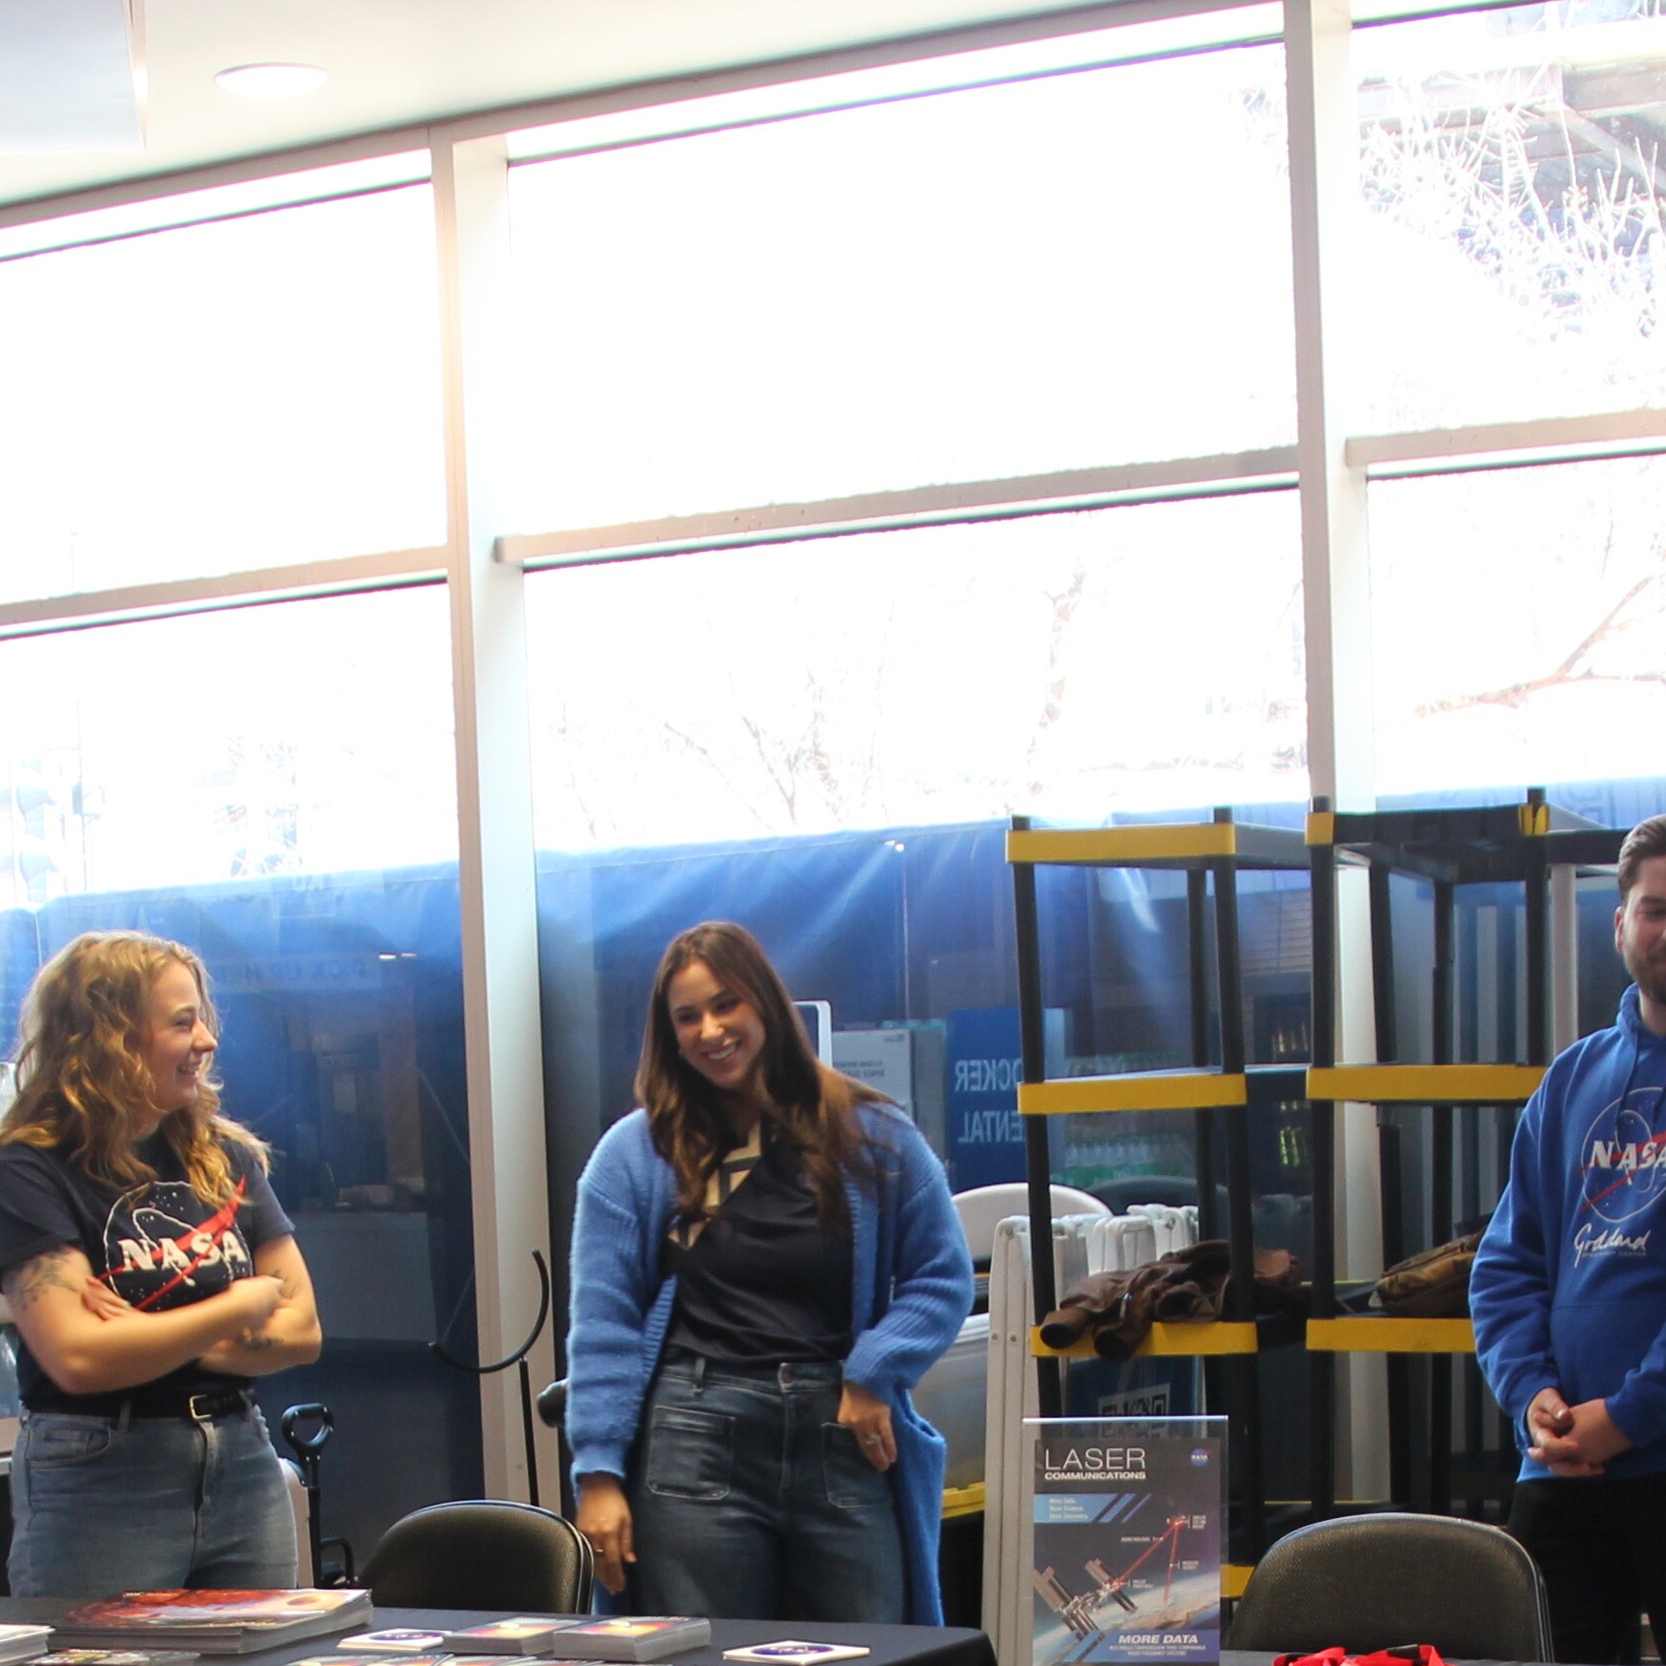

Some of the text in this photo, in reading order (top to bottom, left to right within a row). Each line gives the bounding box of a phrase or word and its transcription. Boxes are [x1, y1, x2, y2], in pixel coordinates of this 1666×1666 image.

[118, 1231, 249, 1274] NASA
[1574, 1223, 1651, 1268] Goddard
[1045, 1447, 1146, 1470] LASER
[1044, 1471, 1146, 1480] COMMUNICATIONS
[1118, 1634, 1199, 1644] MORE DATA
